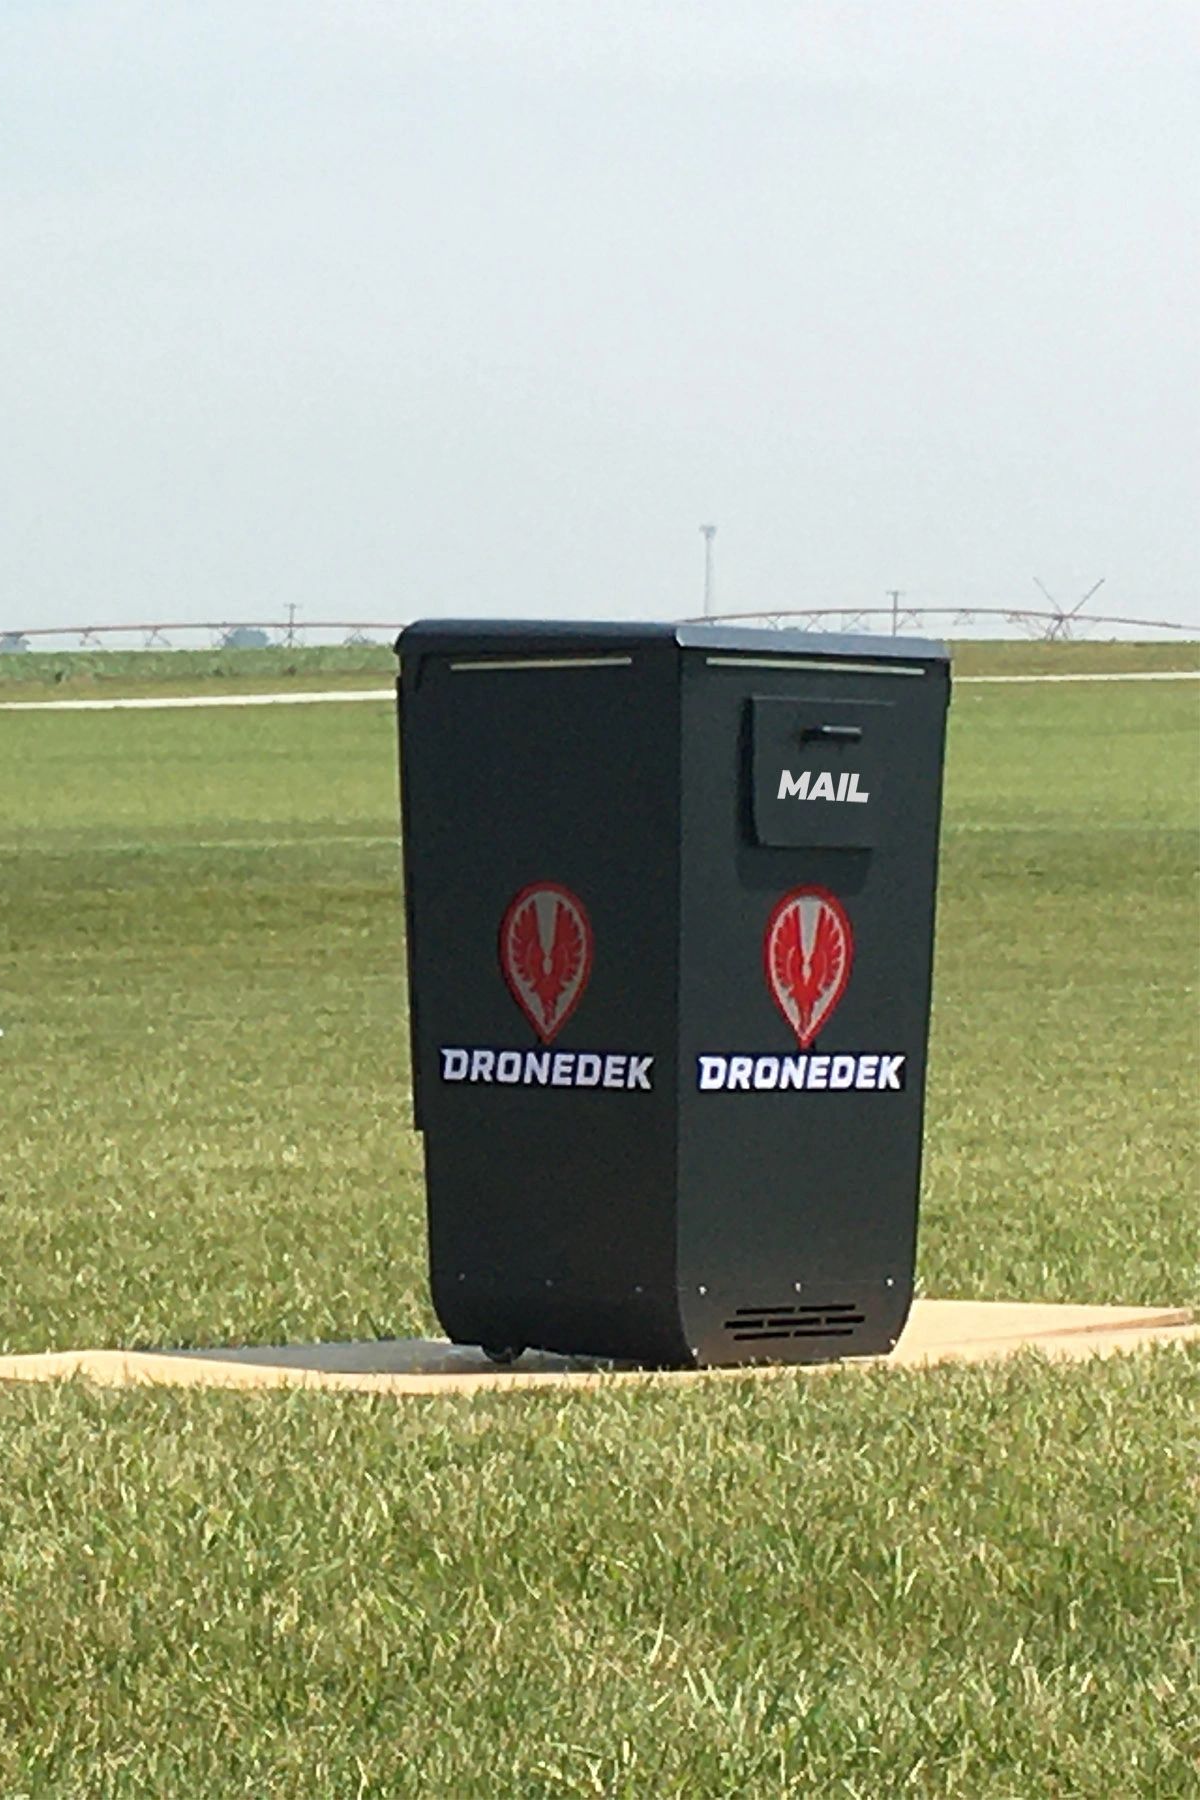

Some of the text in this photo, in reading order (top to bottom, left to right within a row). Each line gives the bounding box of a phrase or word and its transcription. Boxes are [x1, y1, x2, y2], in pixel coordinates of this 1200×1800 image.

[777, 769, 869, 803] MAIL
[441, 1049, 654, 1089] DRONEDEK
[698, 1055, 906, 1090] DRONEDEK
